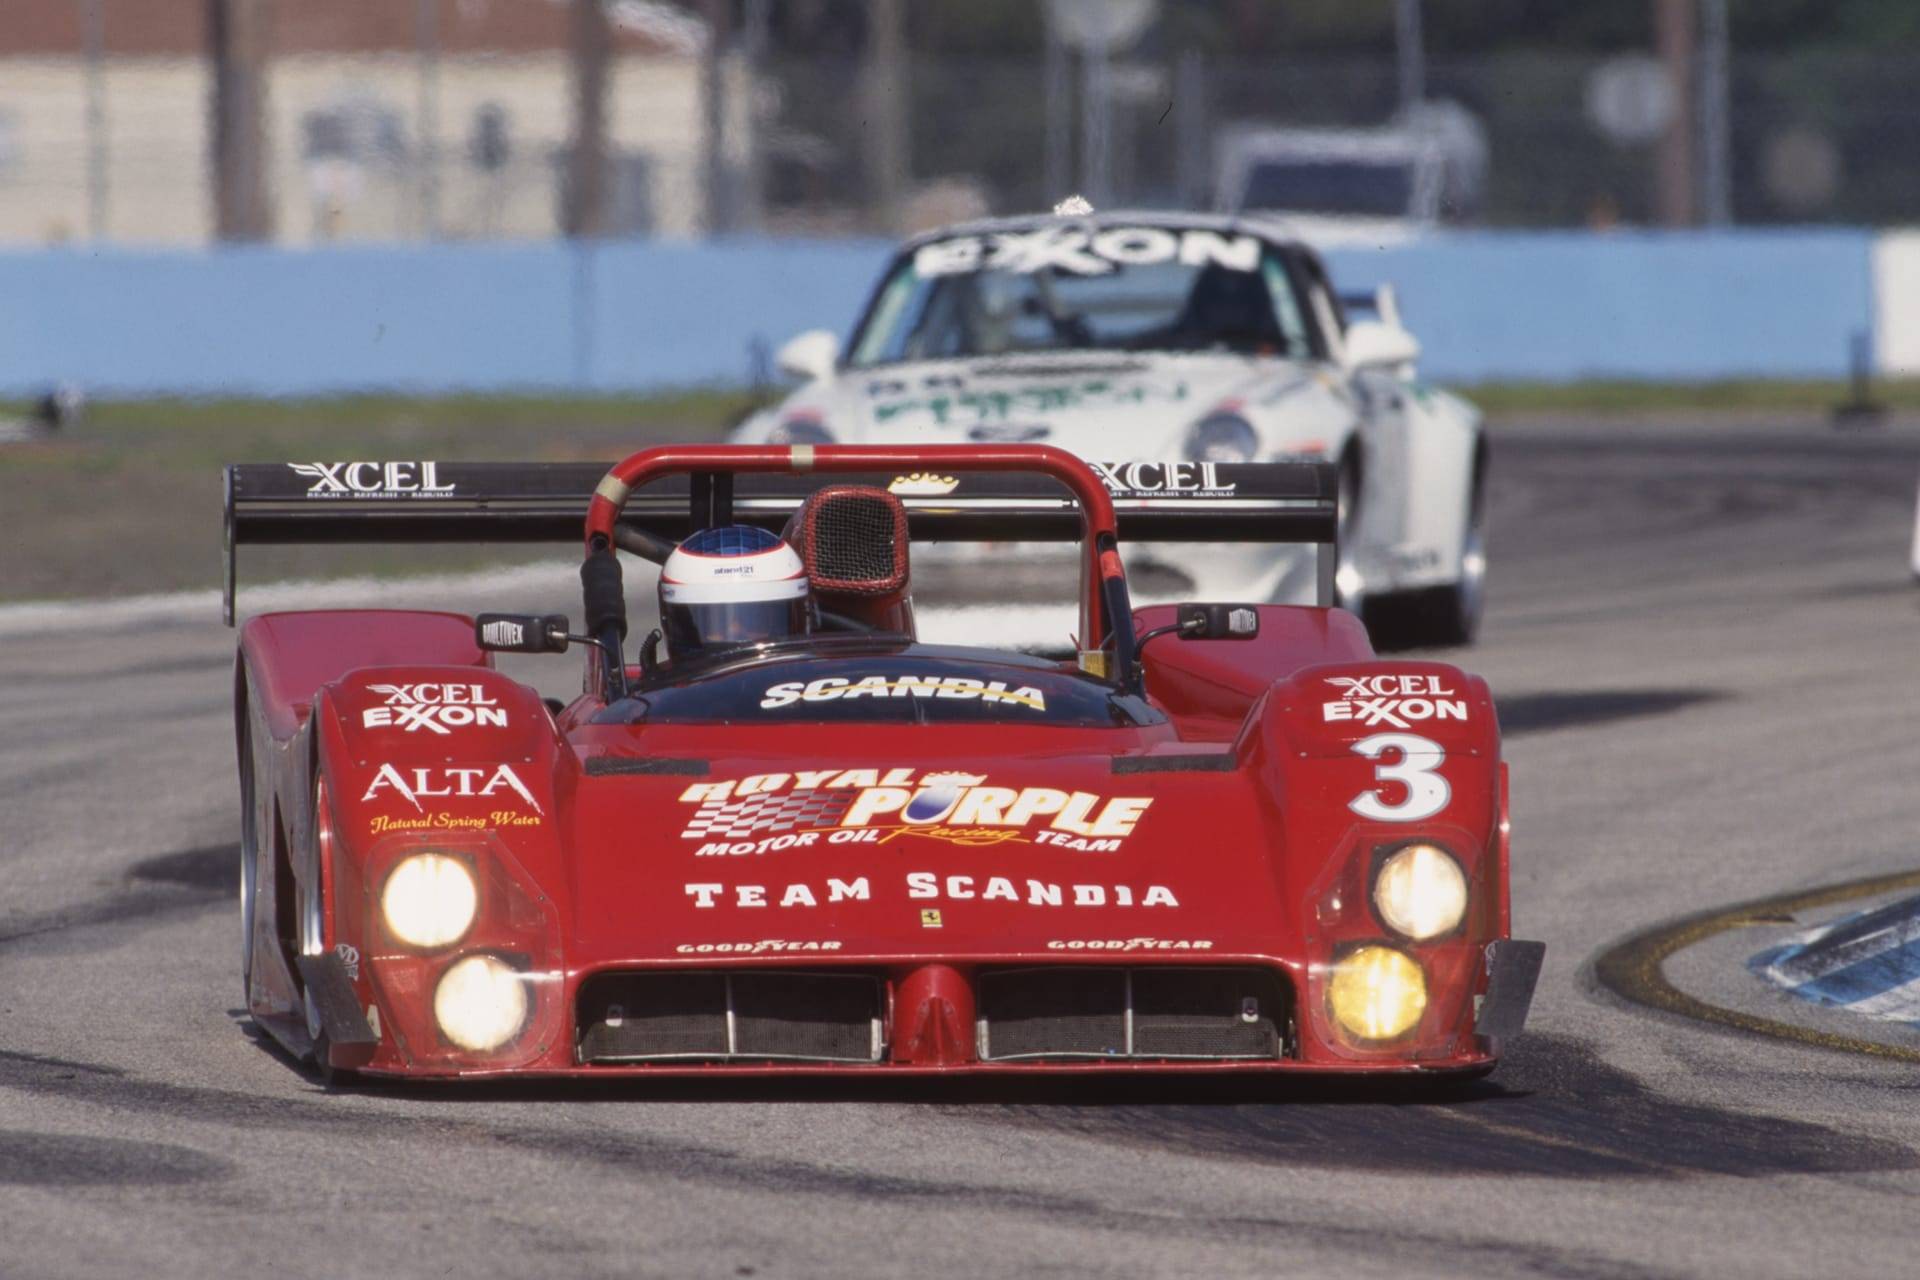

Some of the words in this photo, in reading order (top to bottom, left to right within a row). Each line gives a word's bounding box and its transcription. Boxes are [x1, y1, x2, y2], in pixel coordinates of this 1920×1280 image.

[913, 223, 1262, 276] EXXON
[287, 461, 456, 492] XCEL
[365, 683, 497, 705] XCEL
[760, 676, 1046, 711] SCANDIA
[1323, 675, 1454, 696] XCEL
[362, 704, 508, 734] EXXON
[1322, 698, 1468, 728] EXXON
[361, 763, 545, 816] ALTA
[678, 768, 916, 801] ROYAL
[1347, 731, 1452, 822] 3
[370, 814, 432, 834] Natural
[433, 812, 486, 829] Spring
[490, 811, 541, 826] Water
[840, 786, 1155, 836] PURPLE
[695, 831, 820, 856] MOTOR
[827, 829, 879, 844] OIL
[1035, 829, 1122, 852] TEAM
[685, 877, 870, 908] TEAM
[906, 872, 1179, 906] SCANDIA
